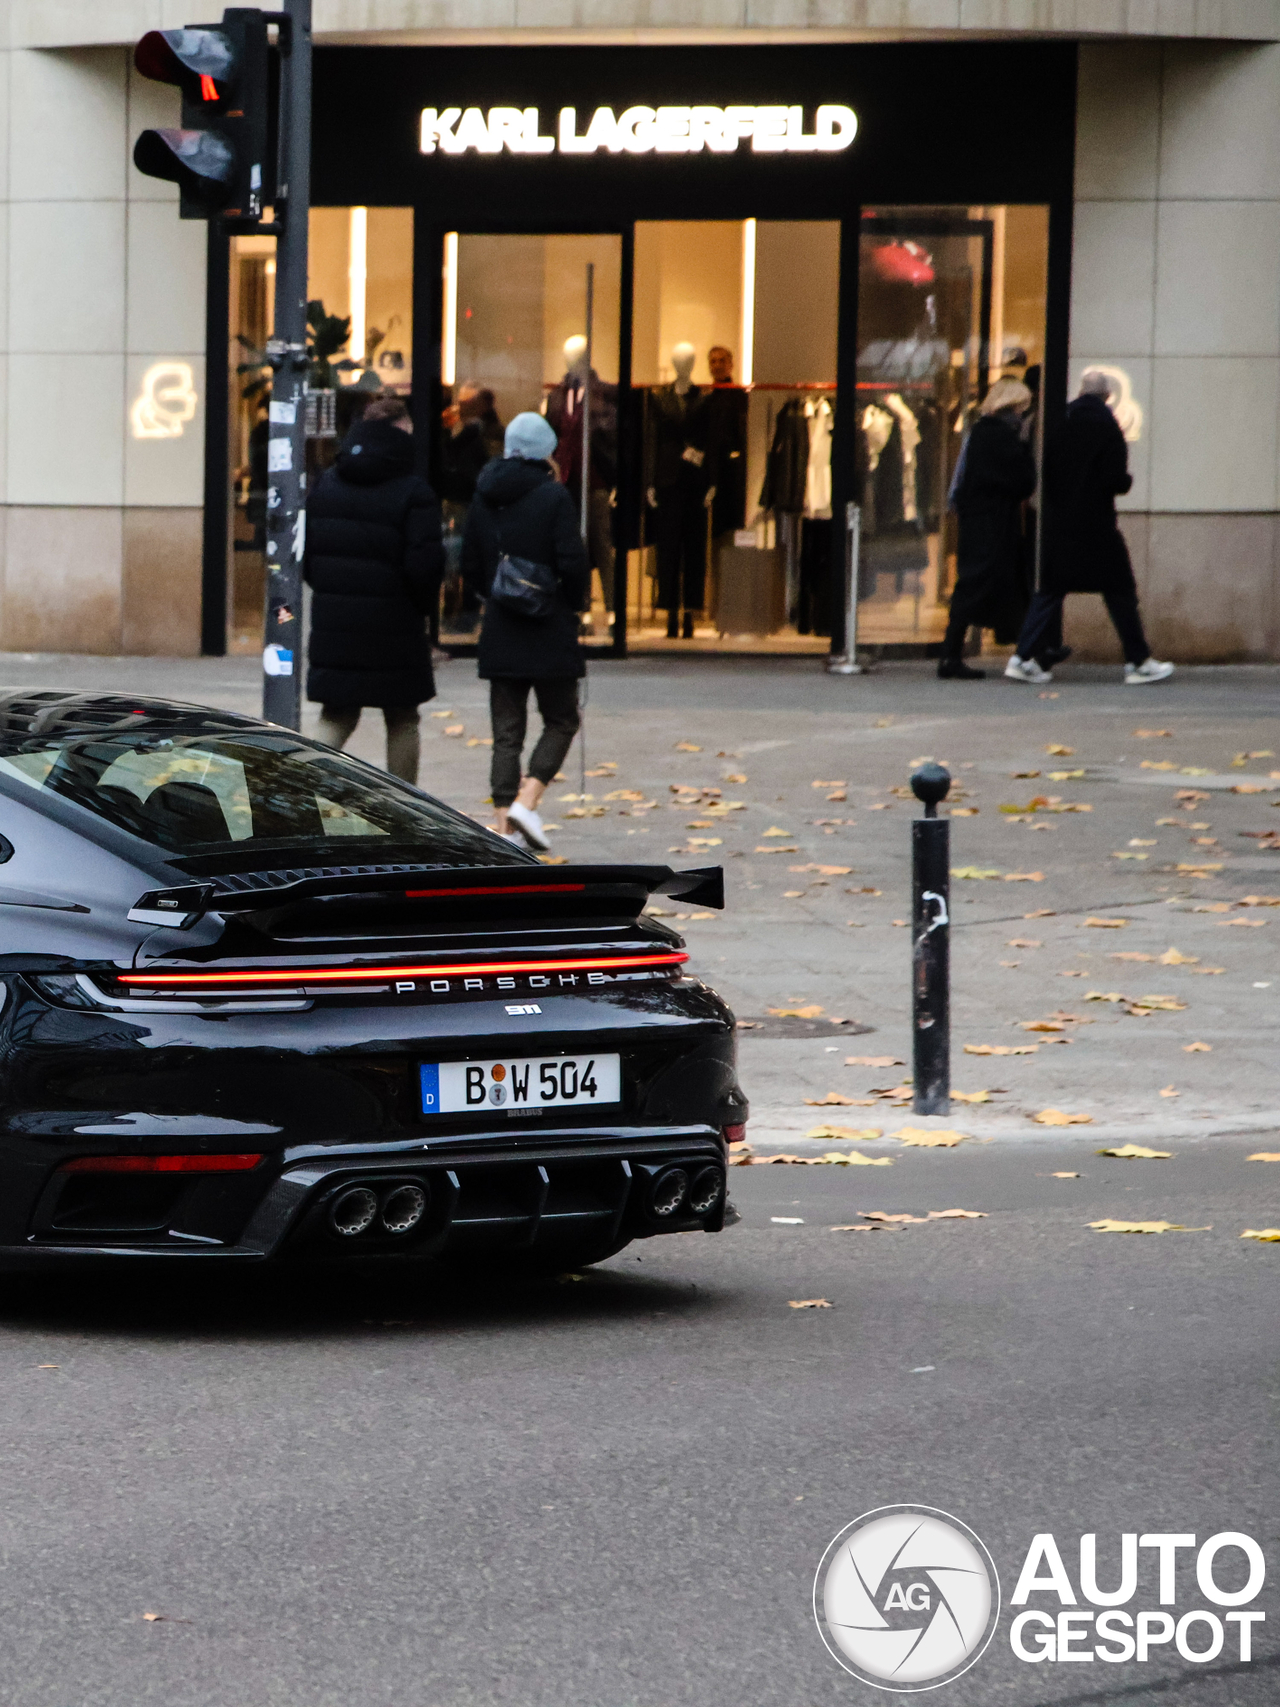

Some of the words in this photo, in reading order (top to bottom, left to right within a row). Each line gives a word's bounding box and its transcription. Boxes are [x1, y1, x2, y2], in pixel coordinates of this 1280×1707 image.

[420, 106, 555, 154] KARL
[558, 104, 858, 154] LAGERFELD
[395, 972, 606, 994] PORSCHE
[504, 1003, 542, 1016] 911
[466, 1066, 486, 1105] B
[511, 1064, 530, 1102] W
[540, 1060, 598, 1101] 504
[426, 1094, 434, 1105] D
[507, 1107, 543, 1118] BRABUS
